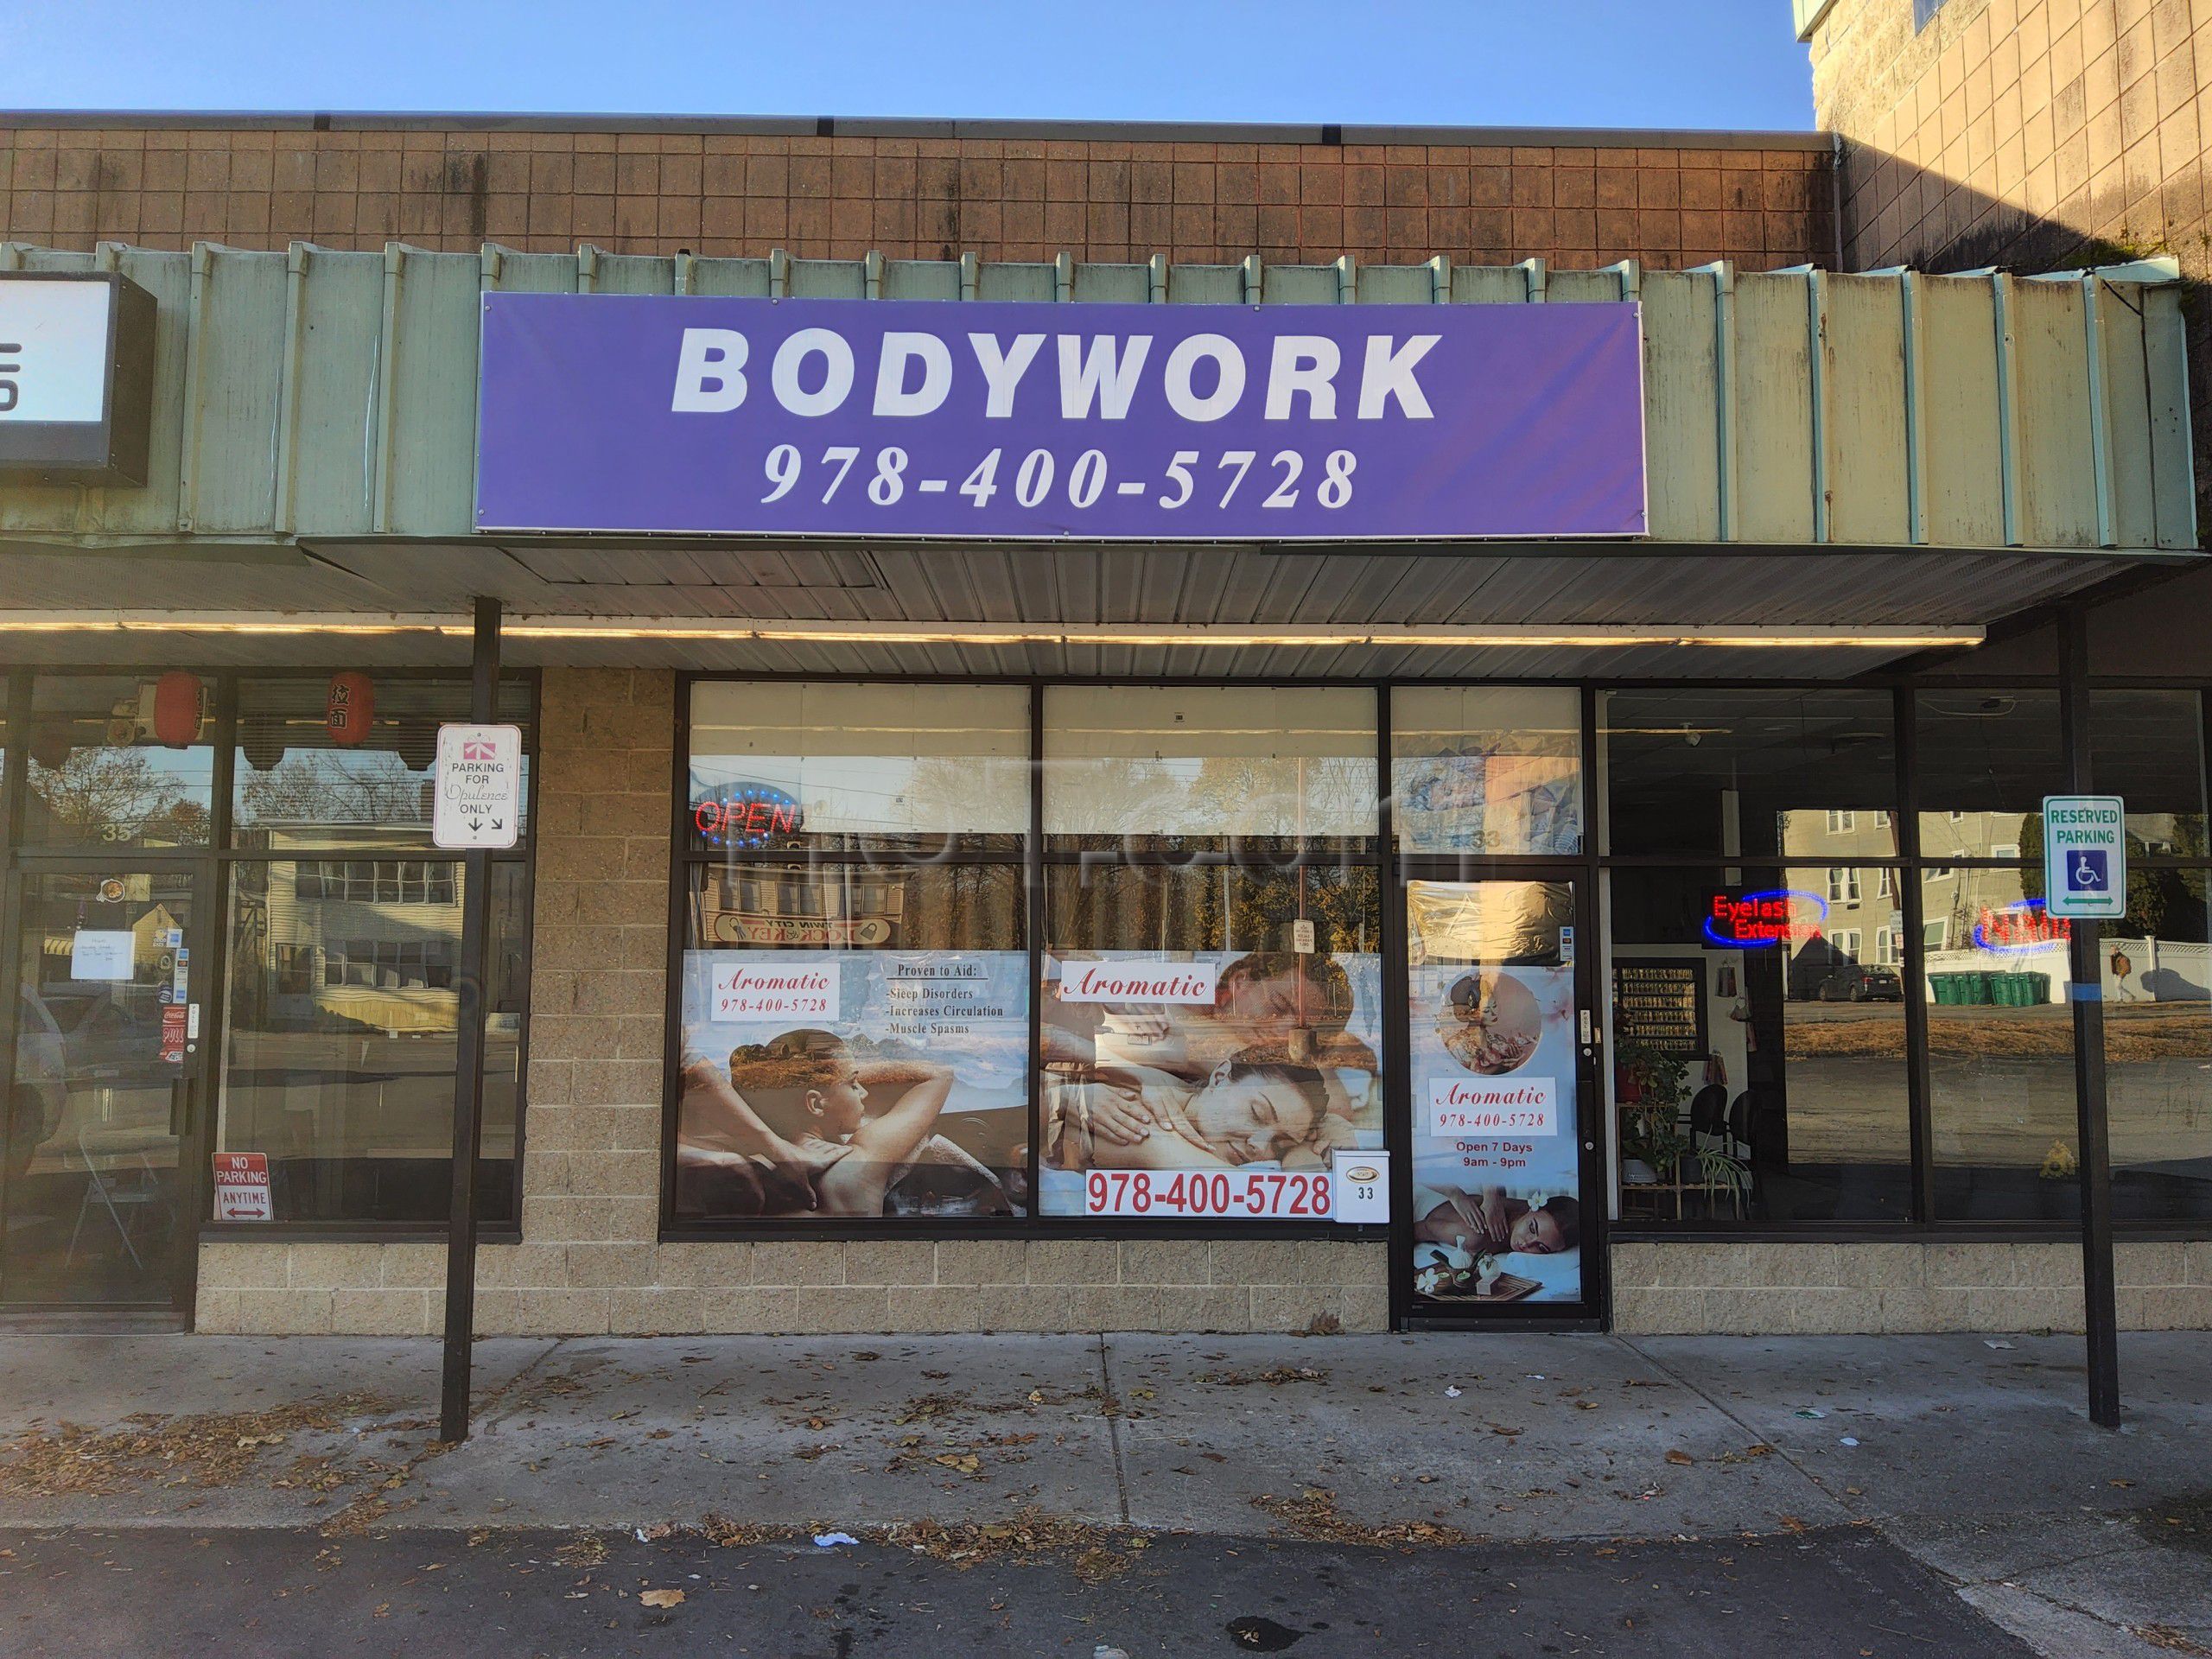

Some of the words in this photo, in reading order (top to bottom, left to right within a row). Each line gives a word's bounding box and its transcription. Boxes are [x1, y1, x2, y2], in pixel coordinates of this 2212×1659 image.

[671, 327, 1443, 422] BODYWORK
[760, 443, 1357, 510] 978-400-5728
[452, 763, 504, 772] PARKING
[466, 775, 489, 784] FOR
[446, 785, 508, 806] Opulence
[460, 804, 493, 814] ONLY
[695, 801, 796, 834] OPEN
[2051, 810, 2118, 823] RESERVED
[103, 823, 131, 842] 35
[1471, 830, 1501, 848] 33
[2056, 830, 2115, 843] PARKING
[1714, 896, 1797, 922] Eyelash
[1735, 918, 1821, 938] Extension
[898, 964, 935, 976] Proven
[940, 966, 950, 976] to
[954, 964, 976, 976] Aid:
[718, 968, 830, 989] Aromatic
[1064, 968, 1207, 997] Aromatic
[922, 988, 973, 999] Disorders
[721, 999, 827, 1012] 978-400-5728
[944, 1005, 1003, 1016] Circulation
[931, 1022, 969, 1036] Spasms
[1436, 1083, 1545, 1105] Aromatic
[1440, 1113, 1544, 1127] 978-400-5728
[1457, 1142, 1488, 1153] Open
[1492, 1142, 1498, 1151] 7
[1503, 1142, 1533, 1154] Days
[232, 1157, 248, 1169] NO
[1464, 1157, 1488, 1166] 9am
[1500, 1157, 1526, 1168] 9pm
[216, 1171, 267, 1184] PARKING
[223, 1192, 266, 1204] ANYTIME
[1089, 1173, 1331, 1215] 978-400-5728
[1358, 1187, 1373, 1199] 33
